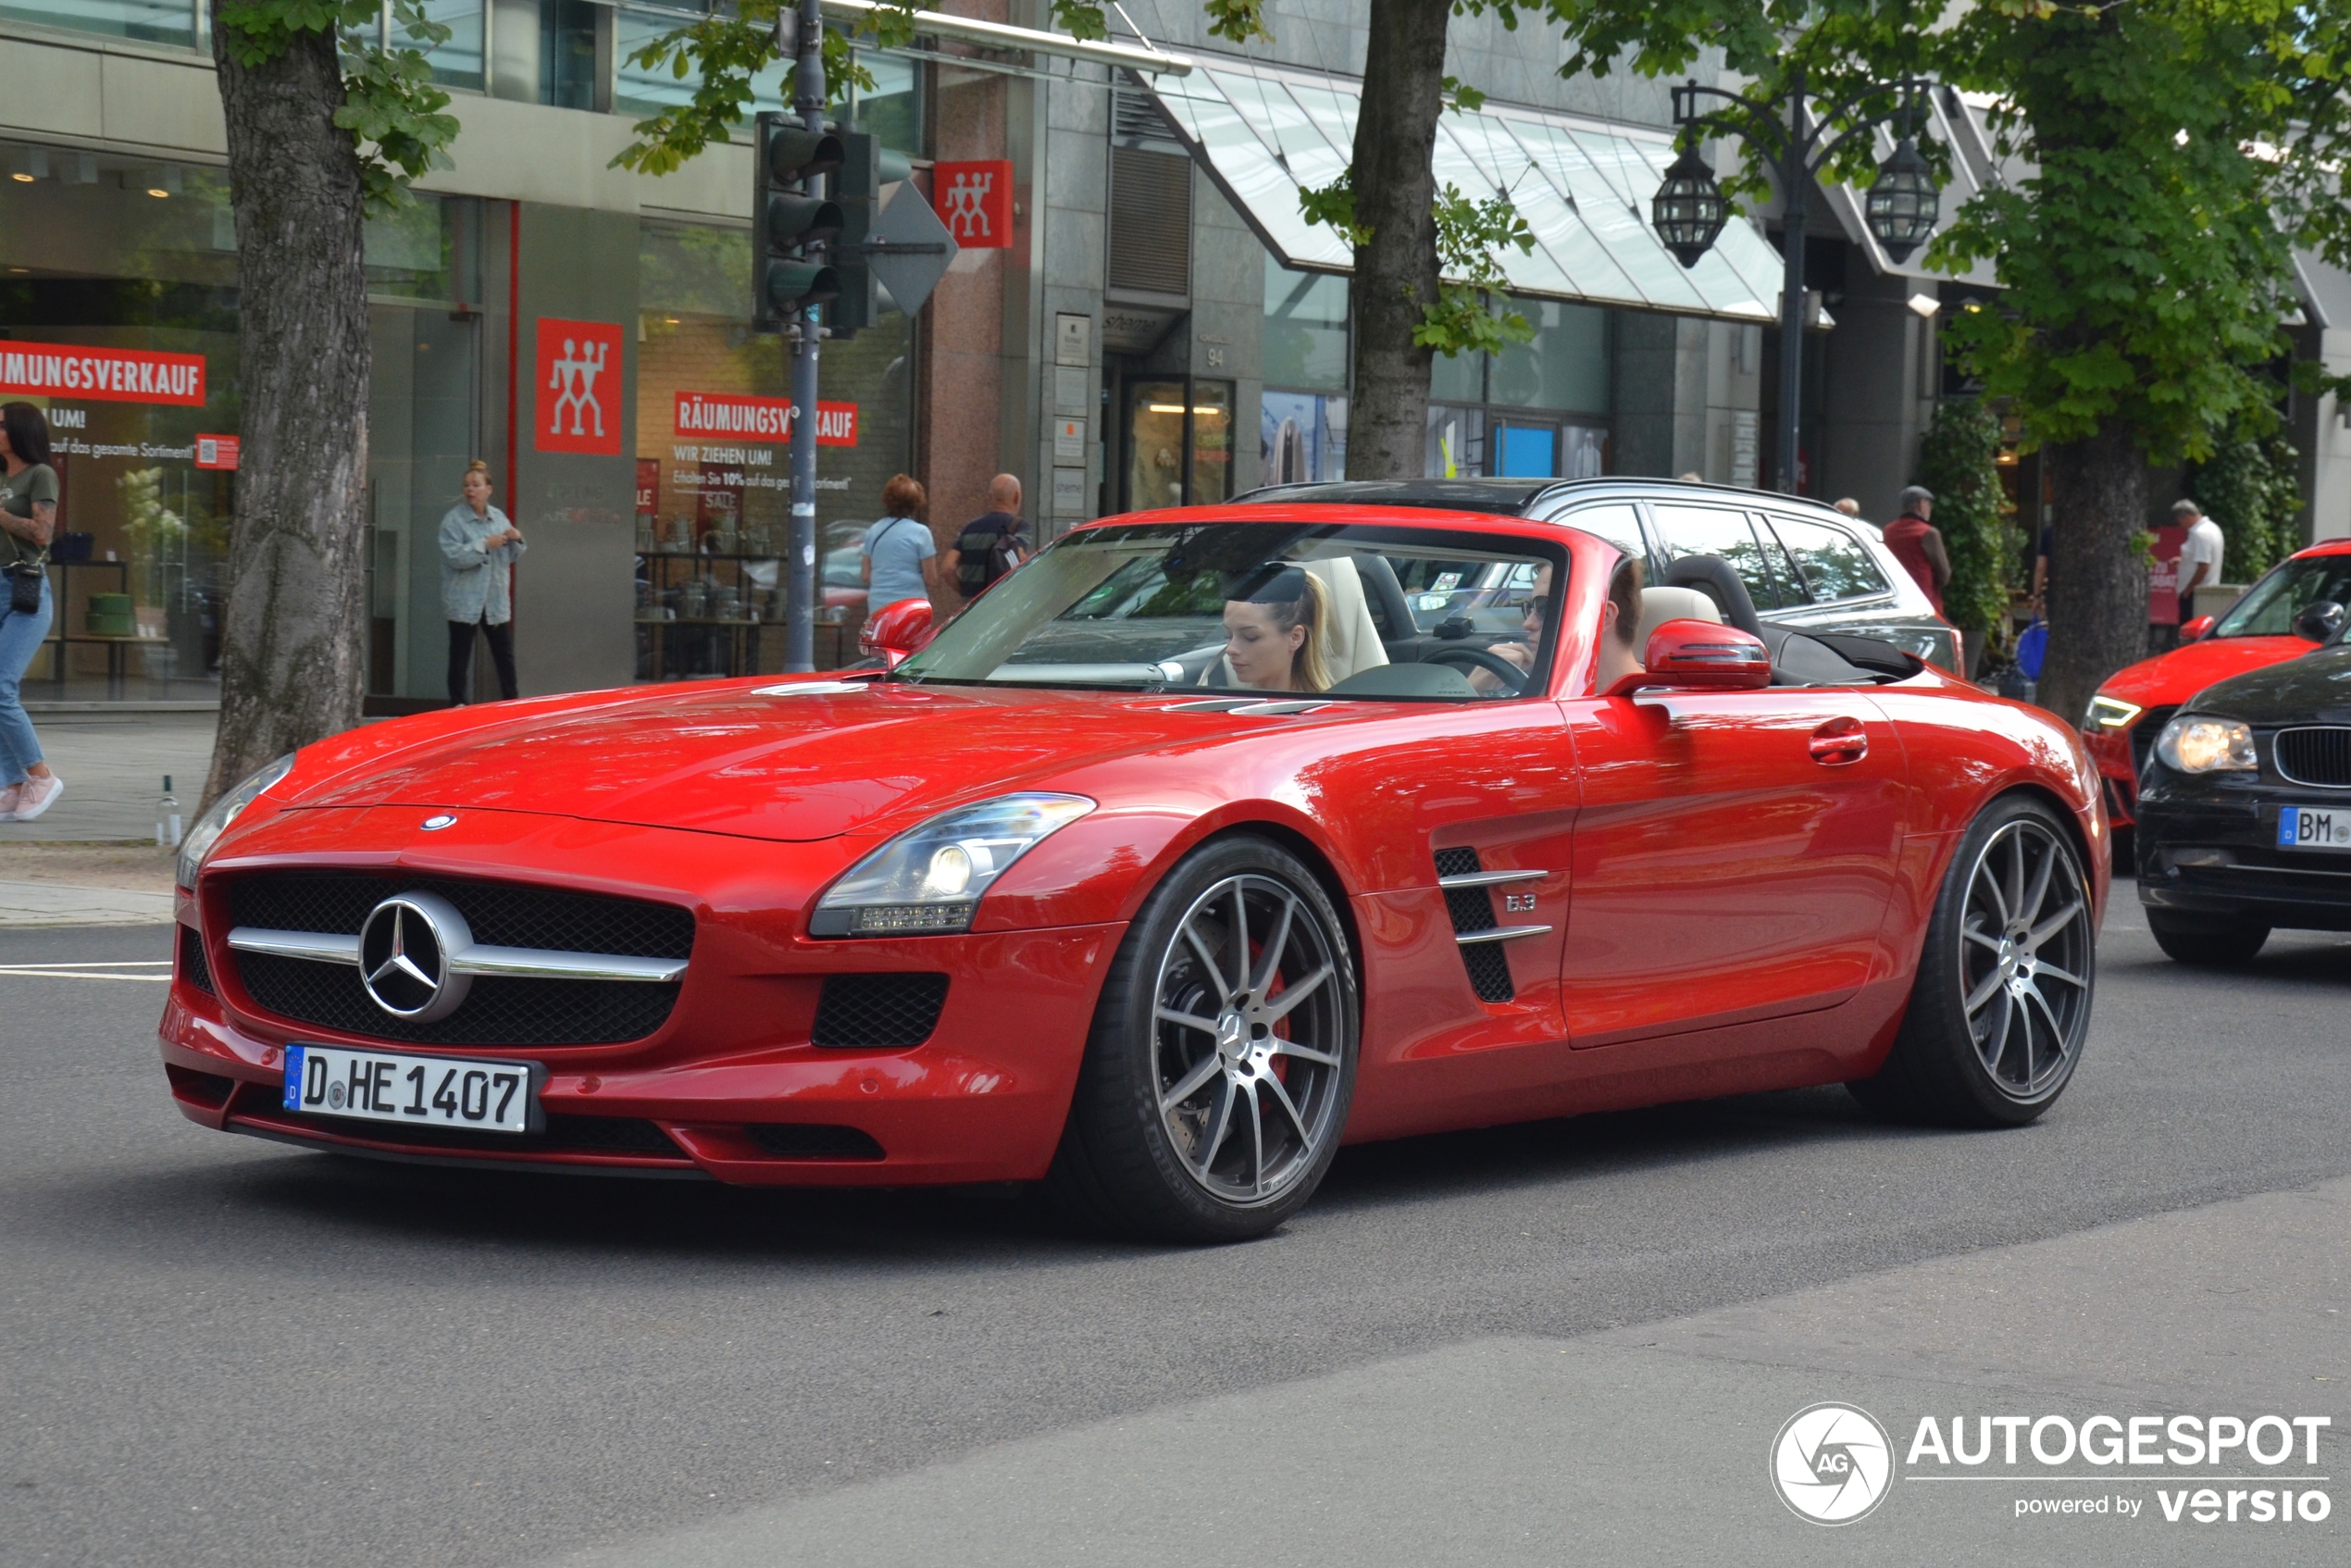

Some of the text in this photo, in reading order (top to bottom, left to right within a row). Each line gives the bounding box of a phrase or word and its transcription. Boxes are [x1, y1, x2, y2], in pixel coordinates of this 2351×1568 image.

[1207, 348, 1224, 367] 94
[0, 352, 199, 396] MUNGSVERKAUF
[51, 408, 86, 429] UM!
[69, 438, 91, 454] das
[93, 443, 139, 459] gesamte
[674, 446, 773, 466] WIR ZIEHEN UM!
[707, 471, 721, 486] Sie
[723, 471, 745, 487] 10%
[746, 472, 760, 487] auf
[761, 474, 776, 488] das
[636, 489, 653, 506] LE
[704, 494, 737, 509] SALE
[2284, 830, 2293, 840] D
[2299, 813, 2332, 842] BM
[289, 1086, 297, 1100] D
